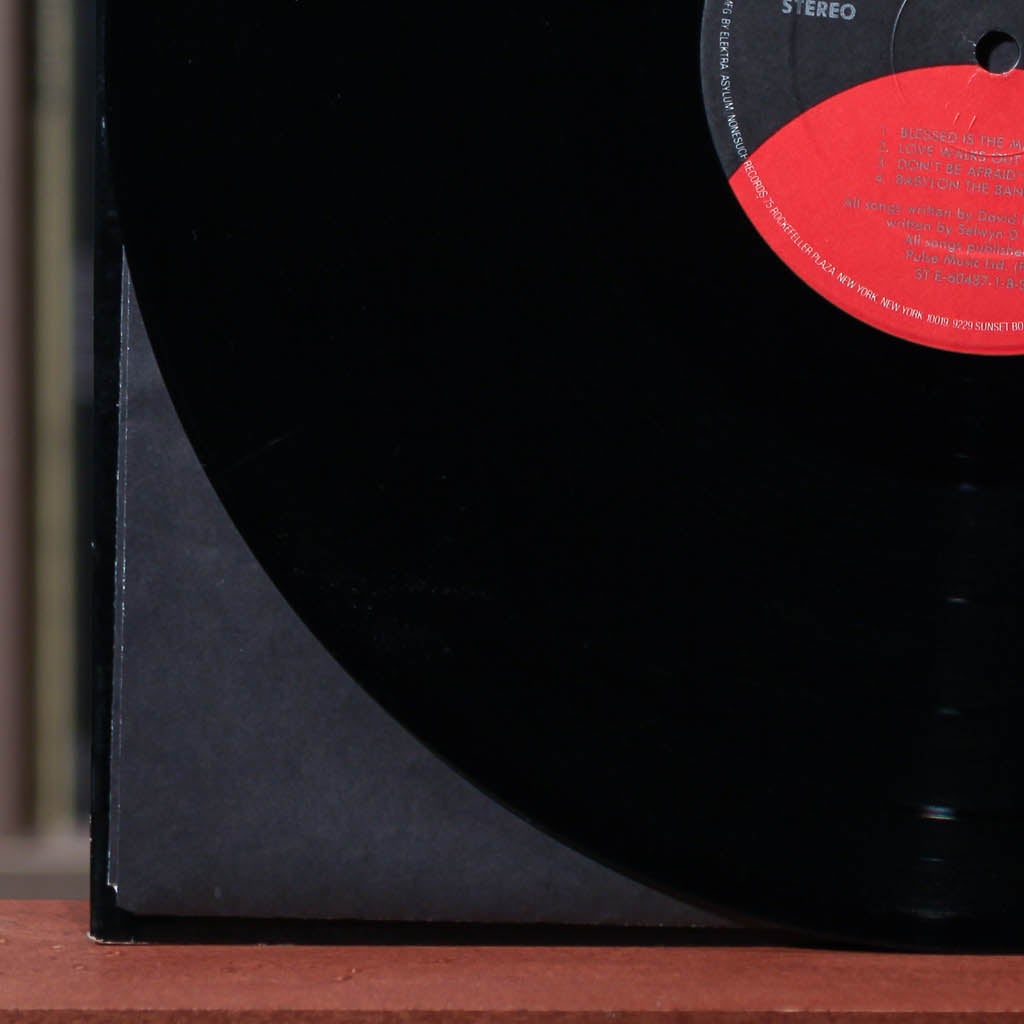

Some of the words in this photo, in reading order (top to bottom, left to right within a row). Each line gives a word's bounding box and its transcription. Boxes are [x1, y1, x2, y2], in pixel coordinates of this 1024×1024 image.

[900, 128, 958, 144] BLESSED
[962, 134, 974, 145] IS
[980, 136, 1003, 148] THE
[898, 144, 934, 157] LOVE
[946, 162, 961, 173] BE
[896, 173, 959, 190] BABYLON
[965, 181, 989, 193] THE
[844, 198, 860, 208] All
[865, 201, 901, 214] songs
[907, 205, 950, 217] written
[957, 208, 972, 222] by
[978, 210, 1017, 224] David
[887, 217, 932, 231] written
[937, 223, 953, 236] by
[958, 224, 1003, 240] Selwyn
[905, 234, 921, 245] All
[925, 239, 961, 252] songs
[905, 249, 939, 264] Pulse
[943, 253, 979, 267] Music
[769, 206, 814, 257] ROCKEFELLER
[836, 272, 857, 289] NEW
[880, 297, 901, 312] NEW
[975, 321, 1010, 332] SUNSET
